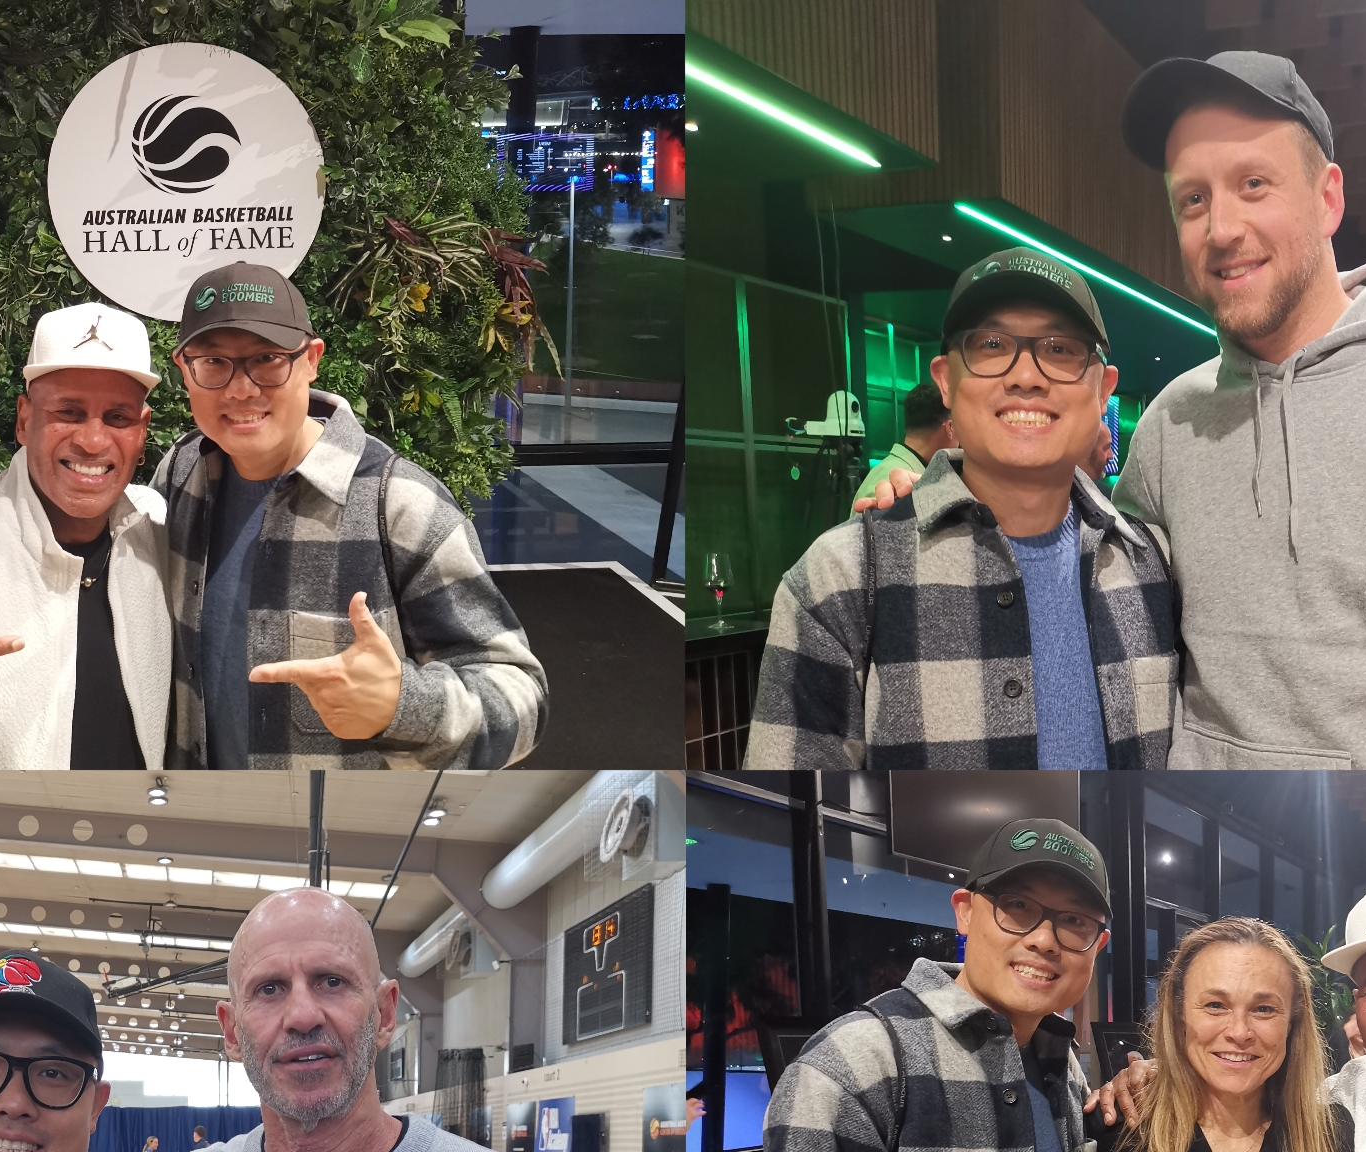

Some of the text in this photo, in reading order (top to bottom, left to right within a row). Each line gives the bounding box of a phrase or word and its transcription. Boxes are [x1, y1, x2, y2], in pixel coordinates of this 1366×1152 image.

[82, 206, 294, 226] AUSTRALIAN BASKETBALL
[82, 226, 295, 258] HALL of FAME
[221, 283, 274, 294] AUSTRALIAN
[221, 291, 275, 305] BOOMERS
